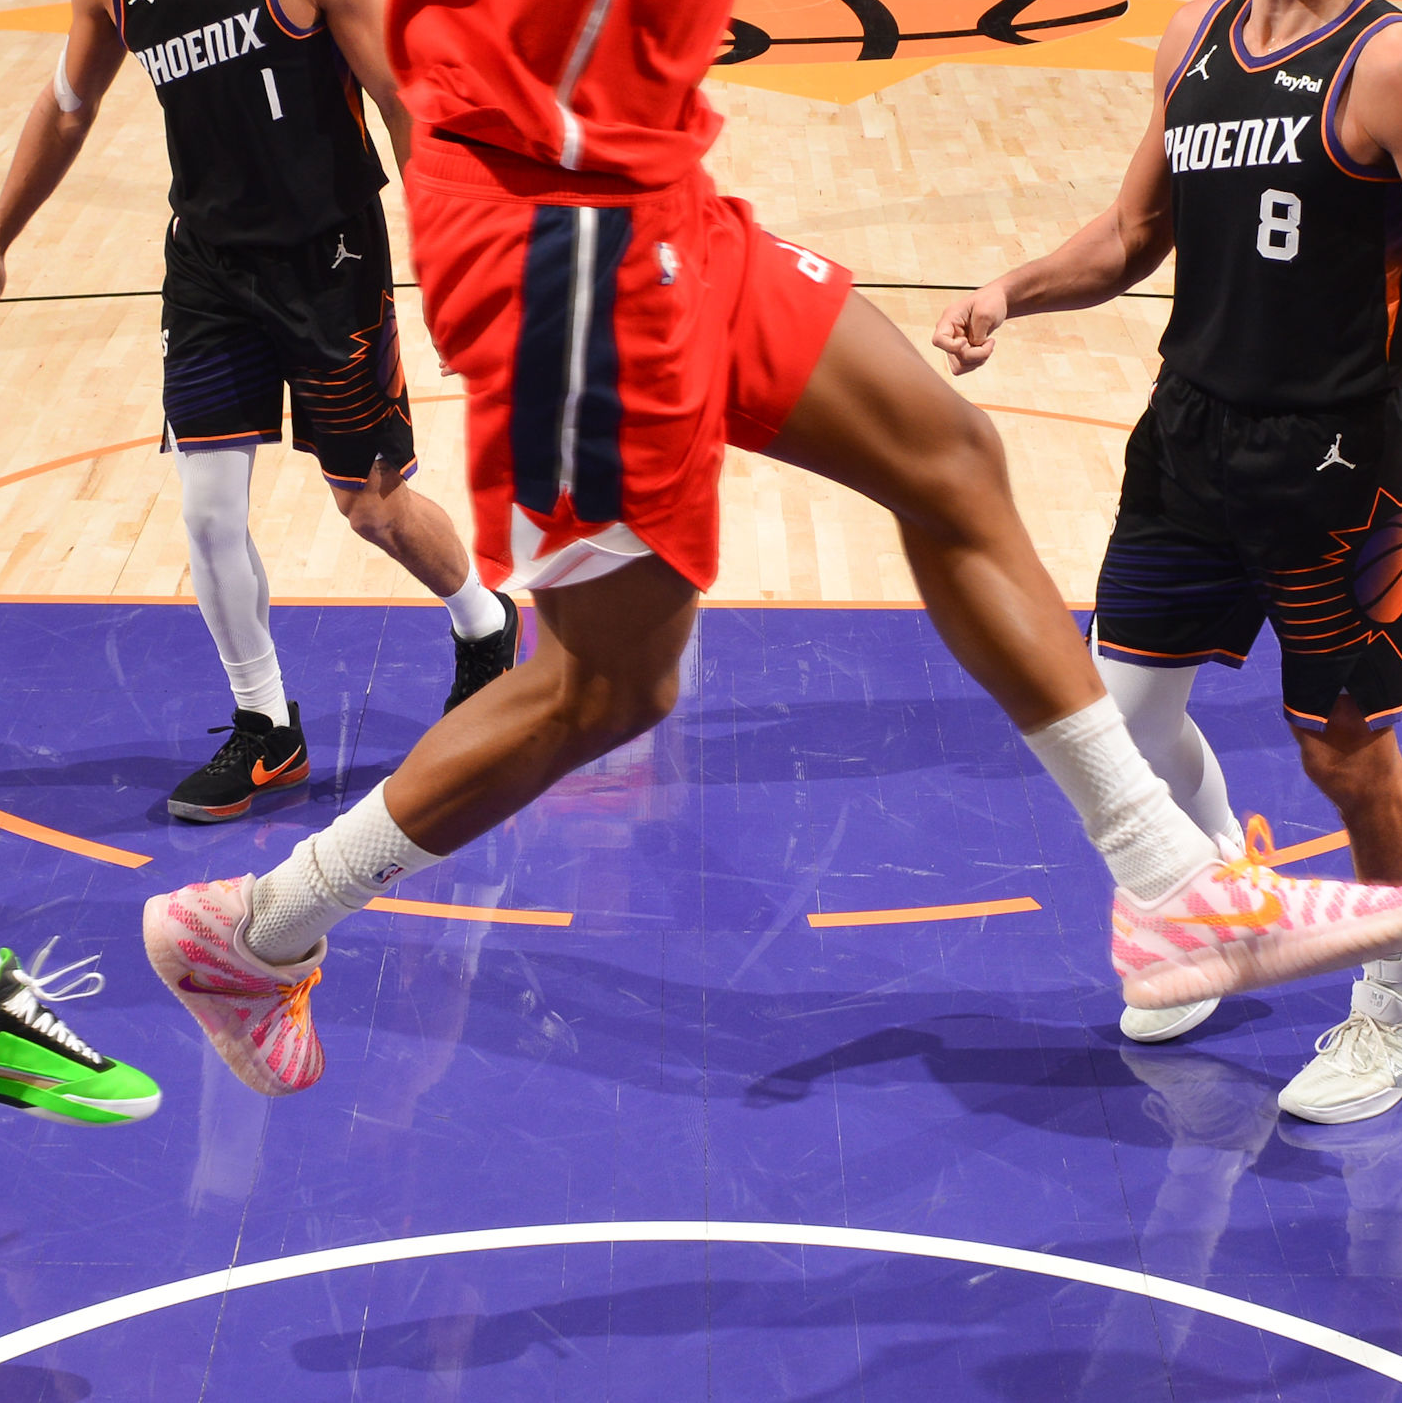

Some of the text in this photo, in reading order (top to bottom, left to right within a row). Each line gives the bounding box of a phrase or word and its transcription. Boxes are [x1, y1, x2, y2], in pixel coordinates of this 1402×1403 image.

[260, 67, 284, 121] 1
[1274, 70, 1324, 94] PayPal
[1163, 114, 1316, 174] PHOENIX
[1255, 188, 1302, 263] 8
